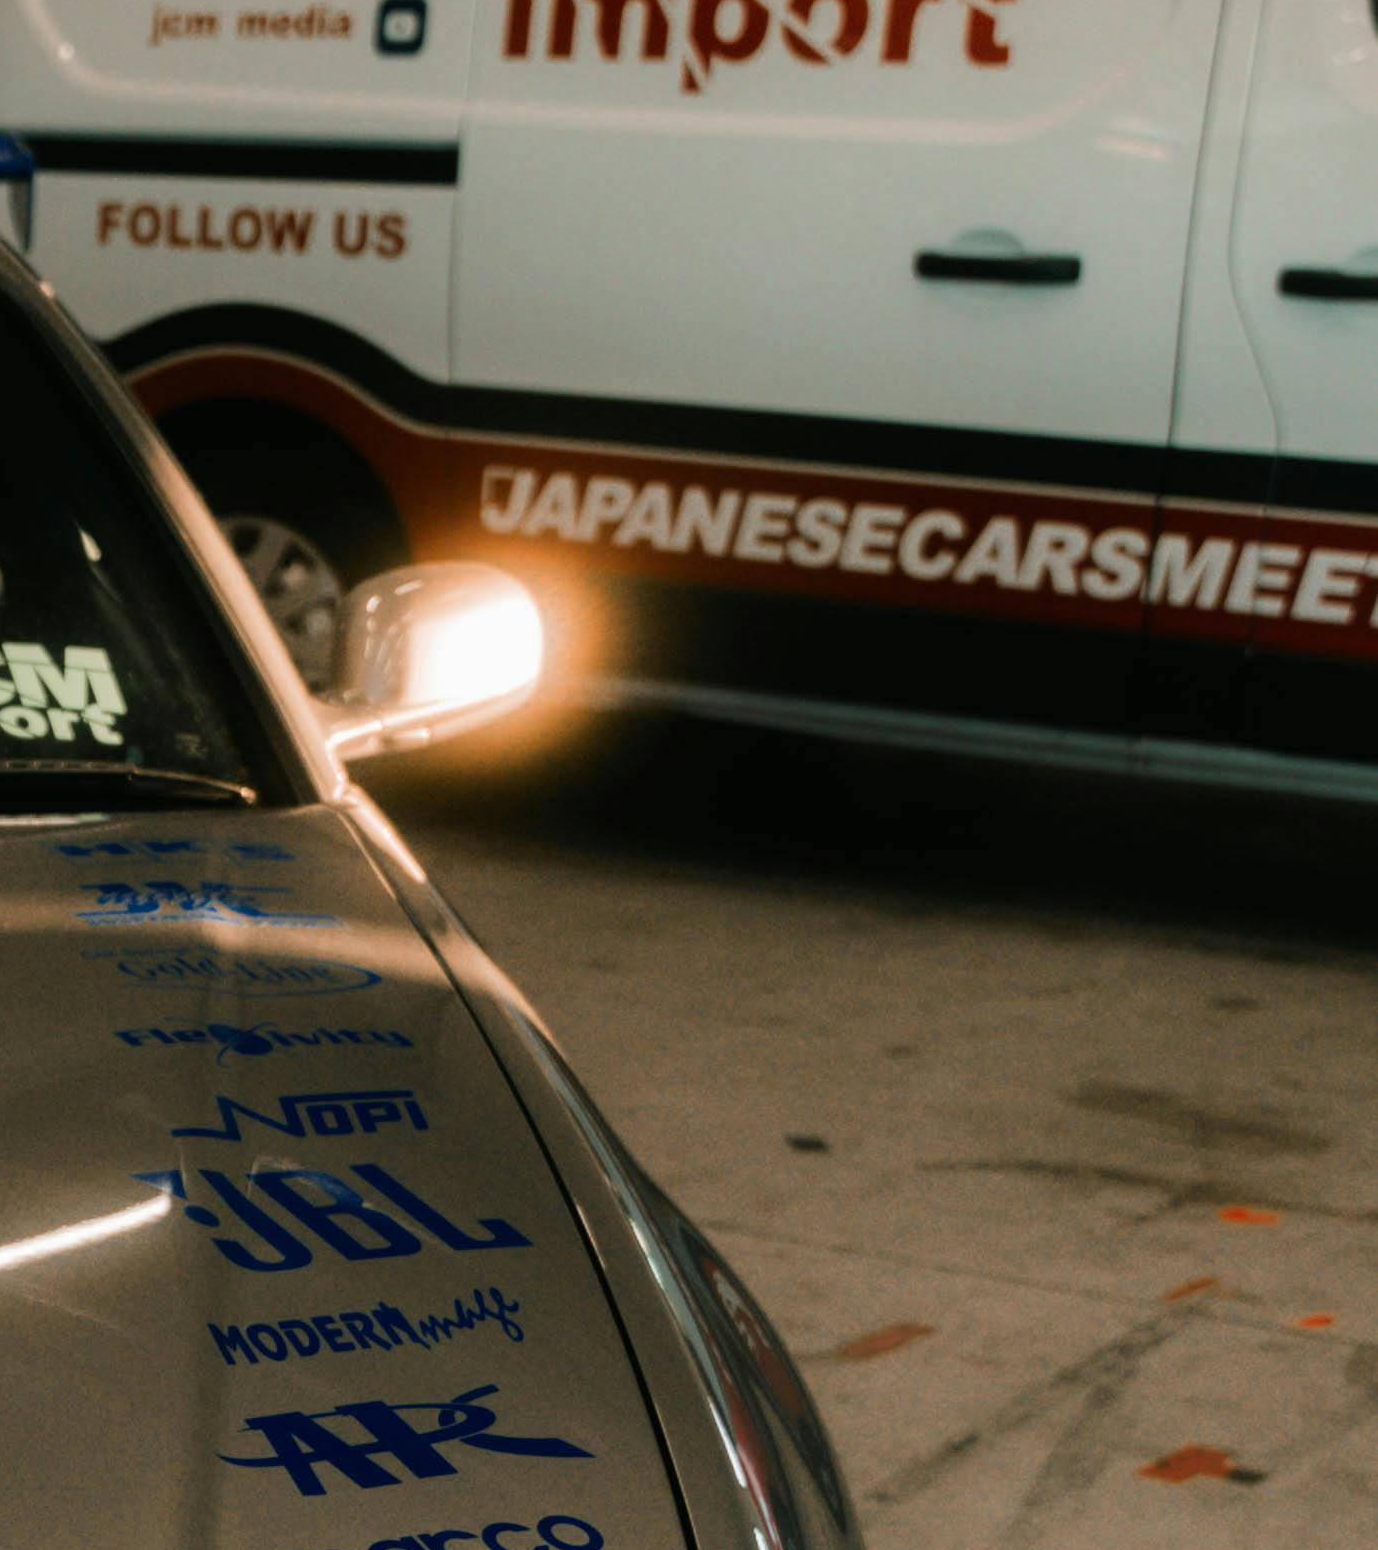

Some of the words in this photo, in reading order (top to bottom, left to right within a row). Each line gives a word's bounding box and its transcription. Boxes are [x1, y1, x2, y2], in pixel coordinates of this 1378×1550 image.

[96, 201, 313, 253] FOLLOW
[332, 209, 407, 261] US
[479, 466, 1378, 630] JAPANESECARSMEE
[171, 1090, 430, 1142] NOPI
